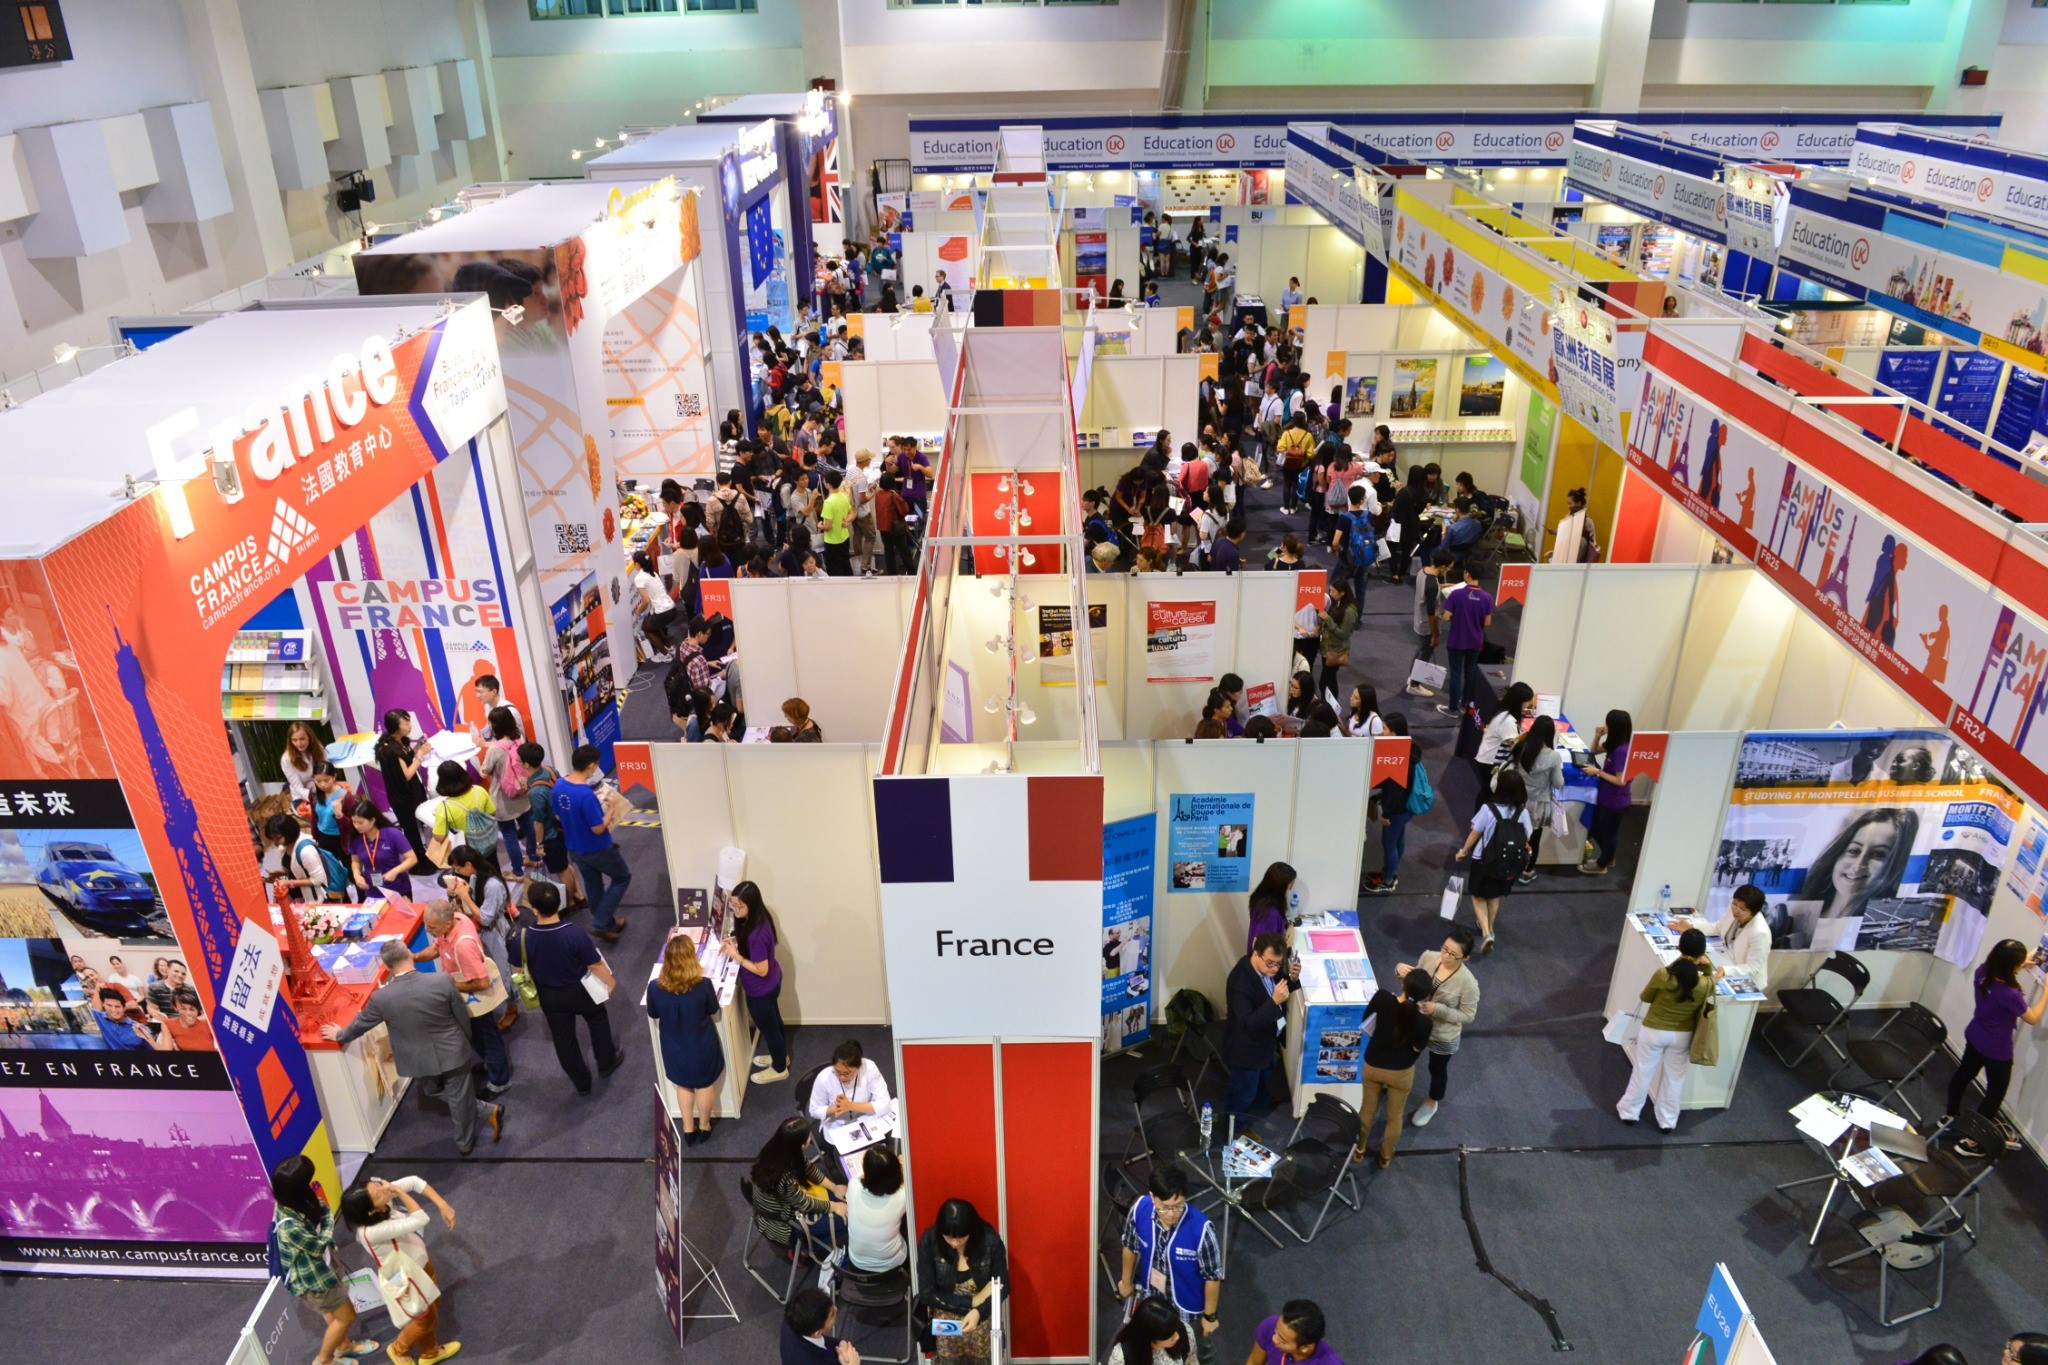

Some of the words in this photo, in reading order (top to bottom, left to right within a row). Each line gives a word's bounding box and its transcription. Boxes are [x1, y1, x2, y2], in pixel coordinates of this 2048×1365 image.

[923, 140, 993, 154] Education
[1043, 138, 1103, 151] ducation
[1144, 136, 1213, 150] Education
[1254, 135, 1287, 149] Educ
[1365, 134, 1433, 147] Education
[1473, 133, 1542, 147] Education
[1797, 133, 1855, 147] Educatio
[1574, 151, 1603, 174] Education
[1857, 152, 1901, 176] Education
[1619, 165, 1654, 188] Education
[1926, 168, 1977, 194] Education
[1674, 183, 1716, 213] Education
[1792, 221, 1850, 259] Education
[1892, 319, 1908, 335] EF
[1553, 326, 1616, 392] 歐洲教育展
[145, 335, 398, 541] France
[301, 424, 393, 507] 法國教育中心
[1783, 473, 1845, 531] CAMPUS
[1778, 500, 1840, 554] FRANCE
[295, 532, 320, 557] TAIWAN
[190, 534, 257, 596] CAMPUS
[1761, 548, 1780, 571] FR25
[195, 555, 264, 619] FRANCE
[332, 579, 497, 605] CAMPUS
[1299, 586, 1322, 594] FR28
[1502, 579, 1525, 587] FR25
[202, 563, 281, 631] campusfrance.org
[703, 594, 726, 602] FR31
[337, 604, 504, 630] FRANCE
[1153, 609, 1188, 621] culture
[1171, 614, 1206, 625] career
[1157, 634, 1187, 644] culture
[1168, 628, 1182, 637] art
[1814, 589, 1828, 606] PSB
[1832, 602, 1848, 621] Paris
[1848, 615, 1871, 641] School
[1870, 635, 1879, 648] of
[1879, 643, 1910, 675] Business
[1151, 643, 1178, 652] luxury
[1994, 621, 2048, 668] CAM
[1955, 711, 1987, 744] FR24
[619, 762, 647, 770] FR30
[1376, 756, 1404, 765] FR27
[1632, 751, 1660, 760] FR24
[1744, 791, 1792, 801] STUDYING
[1793, 791, 1807, 800] AT
[1808, 790, 1876, 800] MONTPELLIER
[1878, 789, 1924, 799] BUSINESS
[1925, 788, 1964, 798] SCHOOL
[1979, 787, 2012, 810] FRANCE
[1944, 813, 1986, 824] BUSINESS
[1103, 829, 1137, 842] ATIONALE
[936, 930, 1054, 957] France
[0, 1062, 31, 1076] EZ
[50, 1062, 78, 1077] EN
[94, 1062, 200, 1079] FRANCE
[1707, 1293, 1731, 1339] EU26
[265, 1308, 290, 1356] CCIFT
